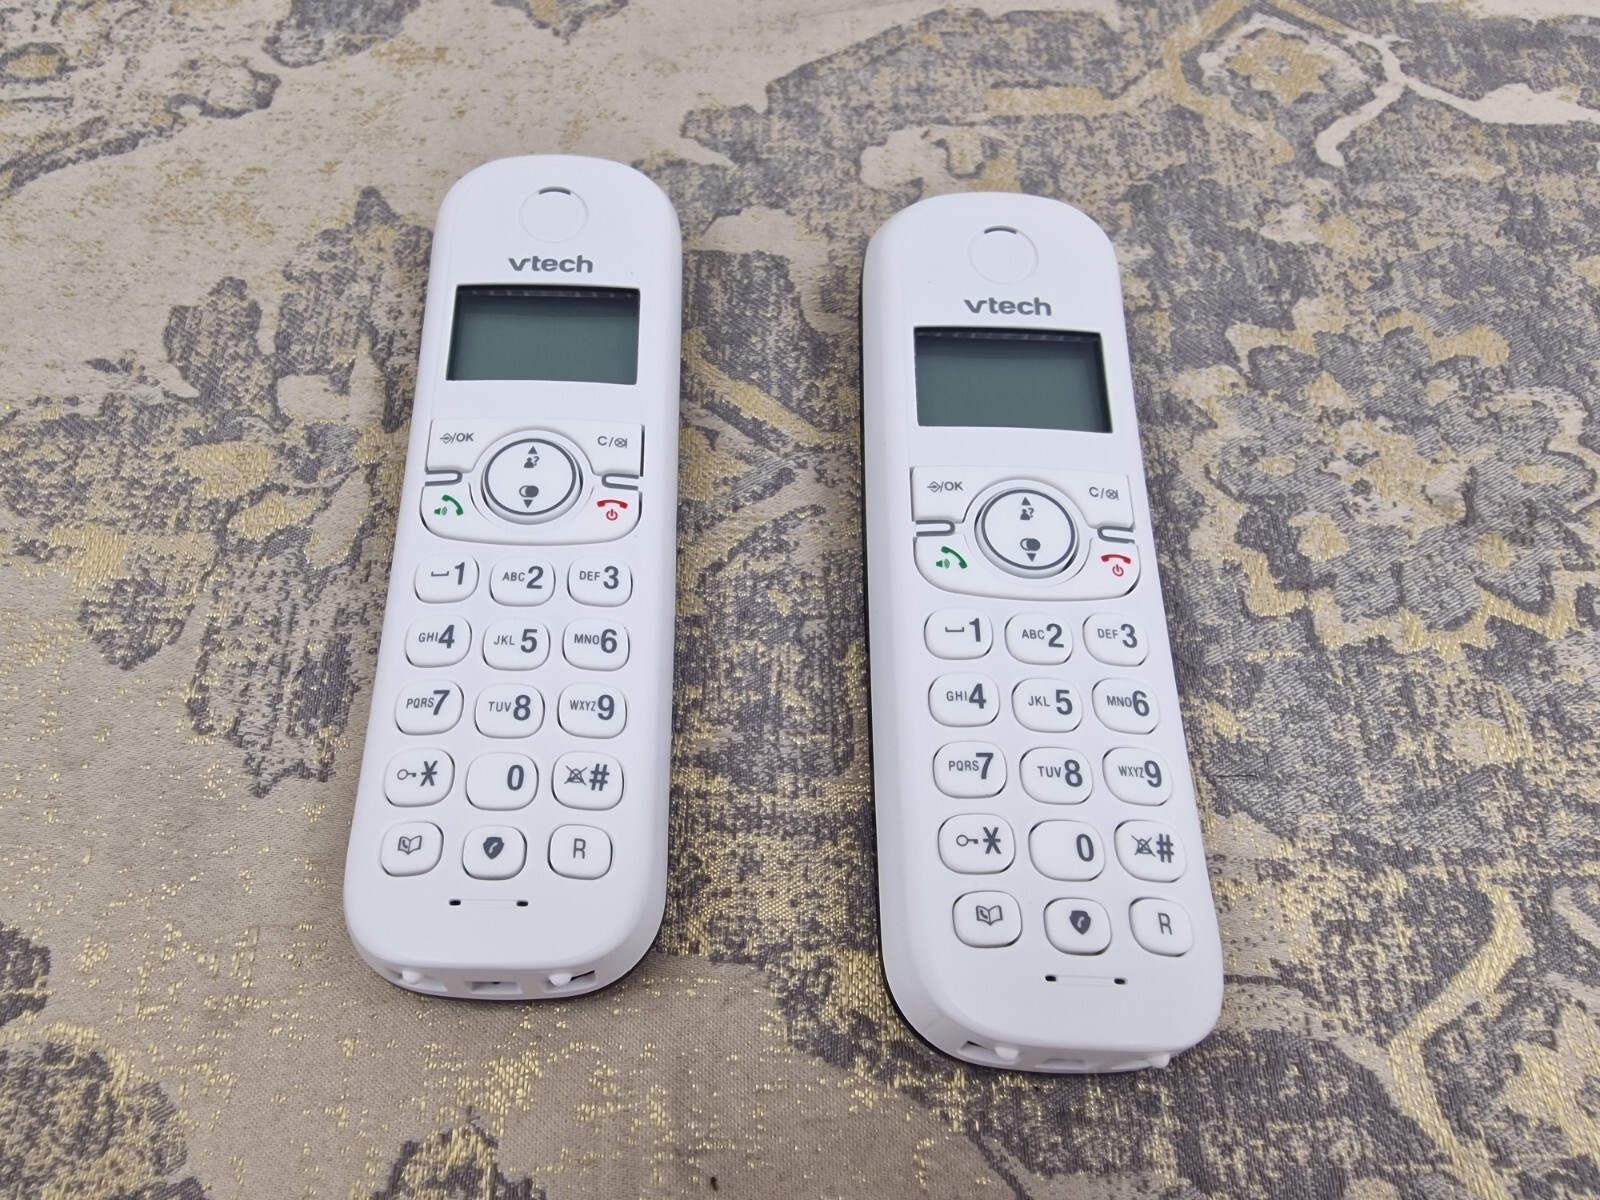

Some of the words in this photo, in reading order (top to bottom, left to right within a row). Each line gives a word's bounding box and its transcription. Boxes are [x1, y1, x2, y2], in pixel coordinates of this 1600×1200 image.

[508, 255, 593, 273] vtech
[964, 298, 1052, 316] vtech
[455, 562, 465, 585] 1
[969, 618, 981, 642] 1
[507, 765, 524, 790] 0
[573, 838, 585, 859] R
[1076, 834, 1094, 862] 0
[1158, 913, 1172, 935] R
